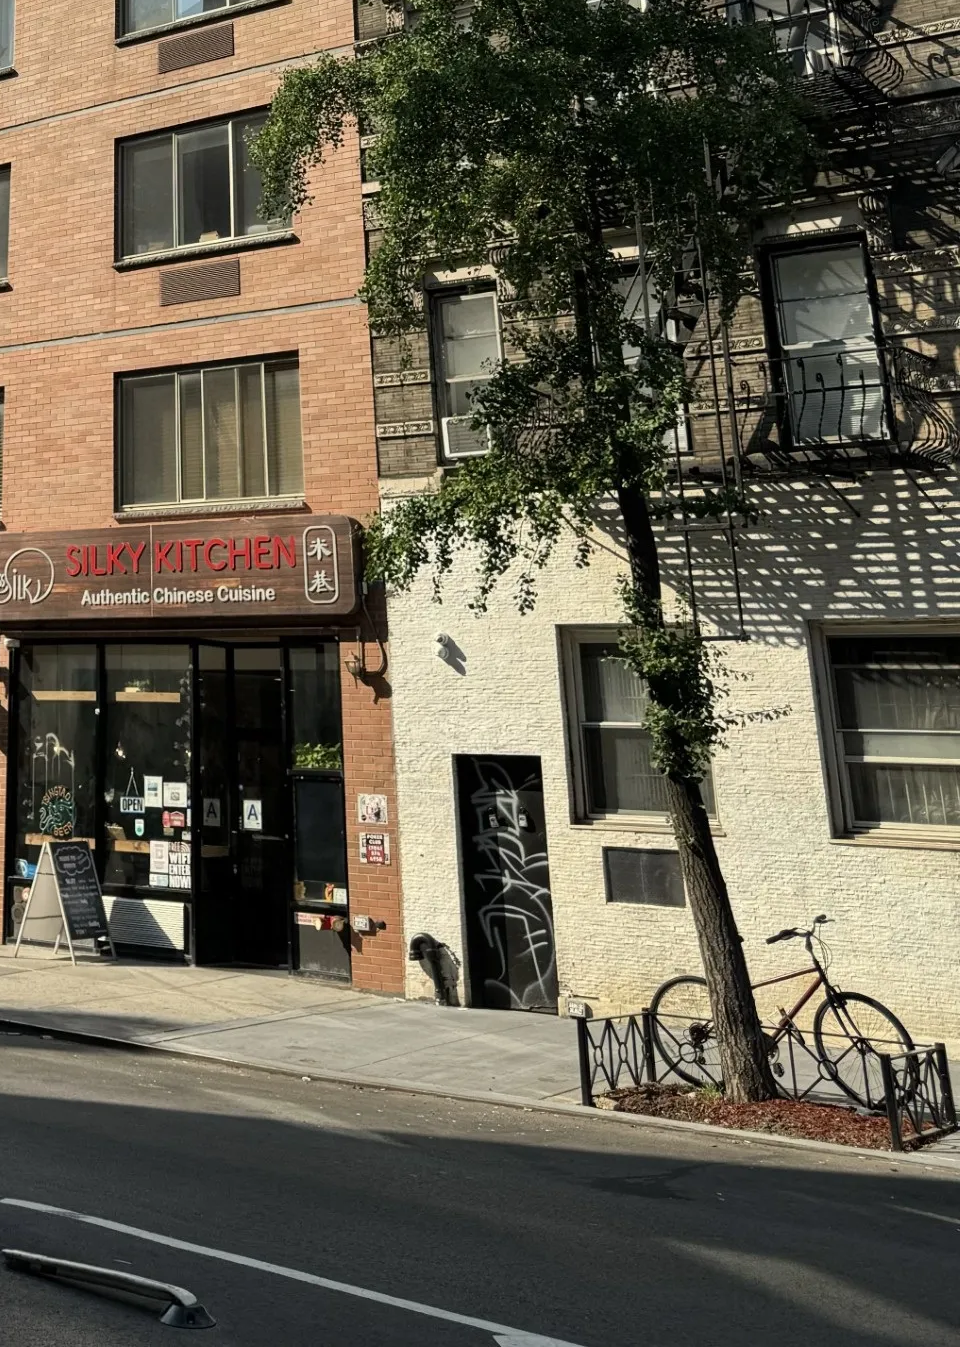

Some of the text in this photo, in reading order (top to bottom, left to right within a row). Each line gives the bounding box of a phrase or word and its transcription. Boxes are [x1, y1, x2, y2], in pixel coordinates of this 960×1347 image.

[65, 536, 296, 576] SILKY KITCHEN
[307, 537, 335, 593] 米巷
[81, 585, 276, 607] Authentic Chinese Cuisine
[41, 785, 71, 805] TSINGTAO
[122, 798, 144, 812] OPEN
[206, 801, 218, 819] A
[246, 803, 259, 821] A
[53, 821, 73, 837] BEER
[169, 852, 190, 864] WIFI
[169, 864, 190, 875] ENTER
